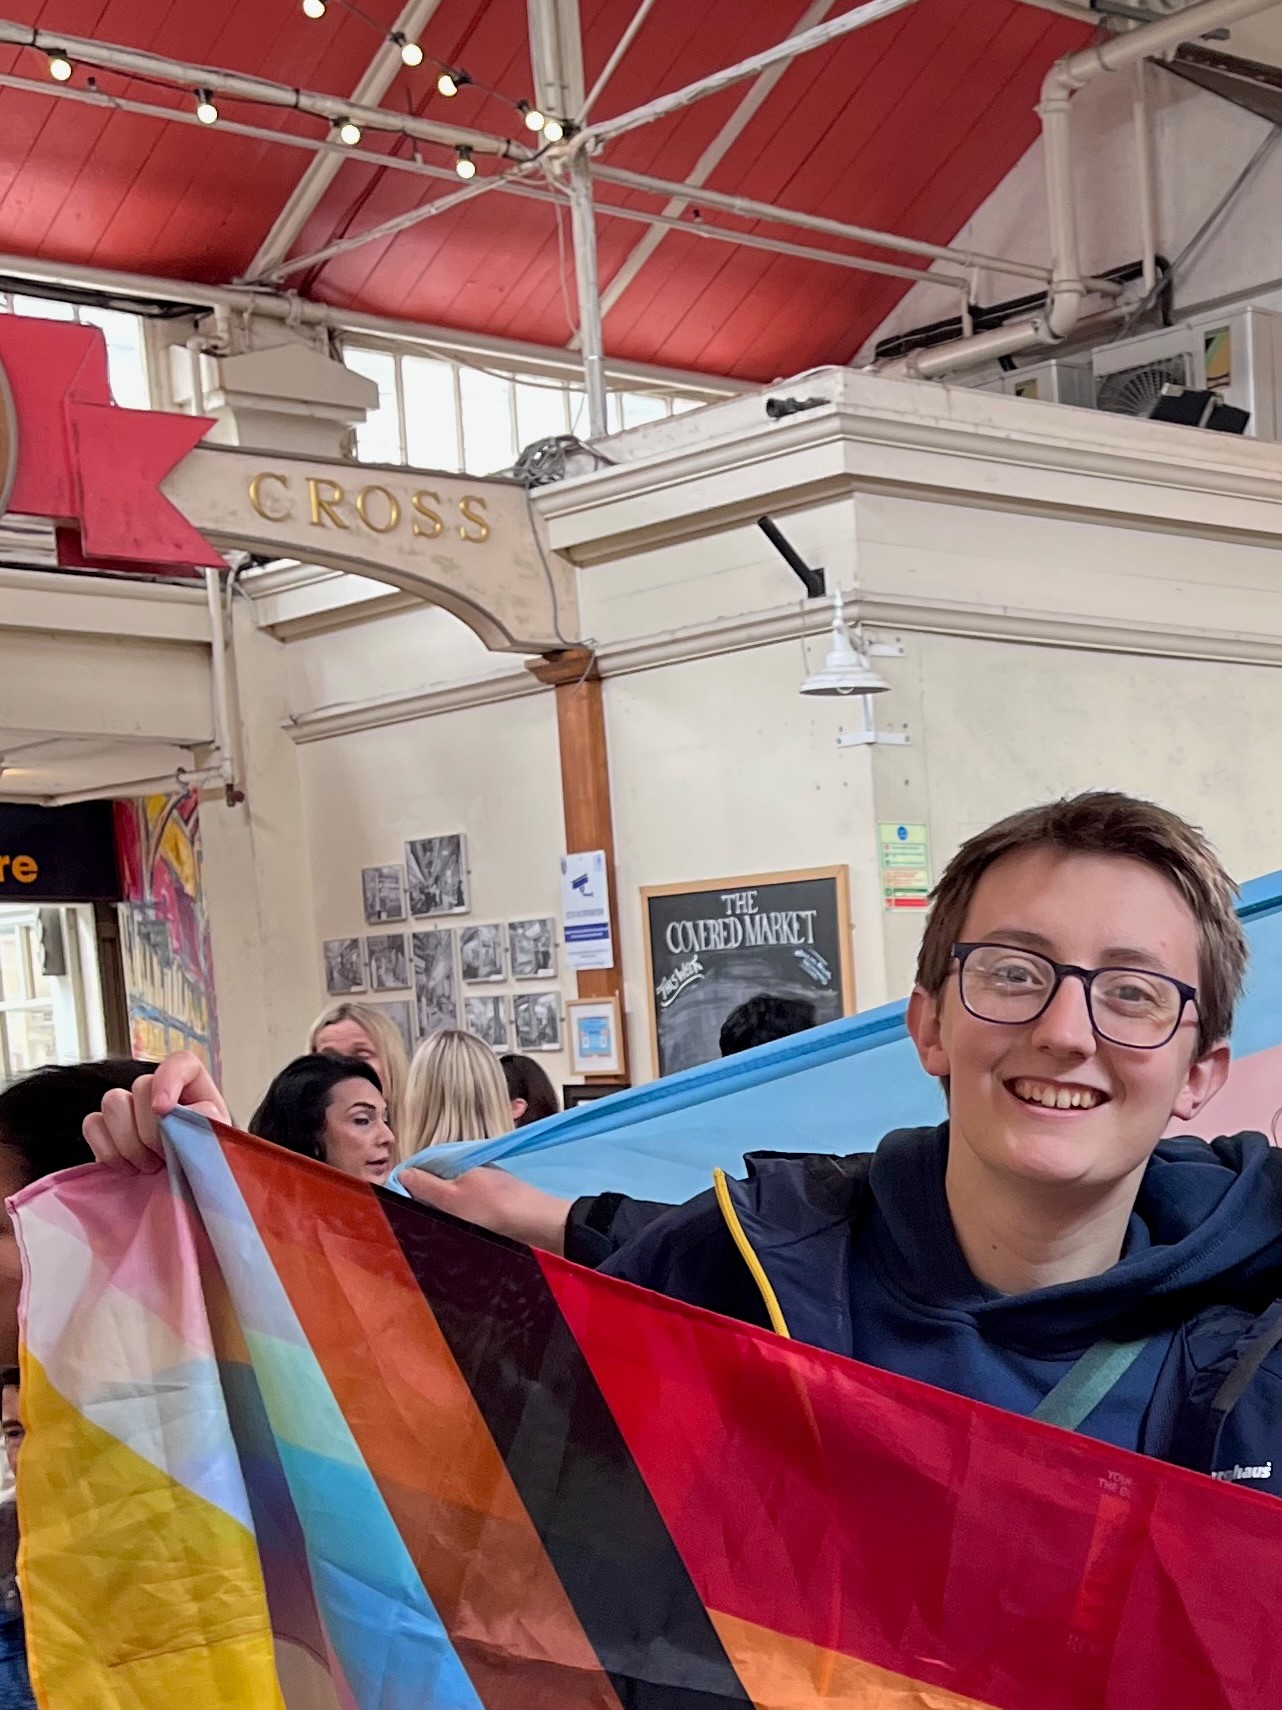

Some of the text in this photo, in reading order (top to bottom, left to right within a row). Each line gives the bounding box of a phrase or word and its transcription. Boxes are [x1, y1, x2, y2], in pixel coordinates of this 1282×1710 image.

[249, 471, 490, 543] CROSS
[721, 890, 759, 915] THE
[666, 910, 817, 953] COVERED MARKET
